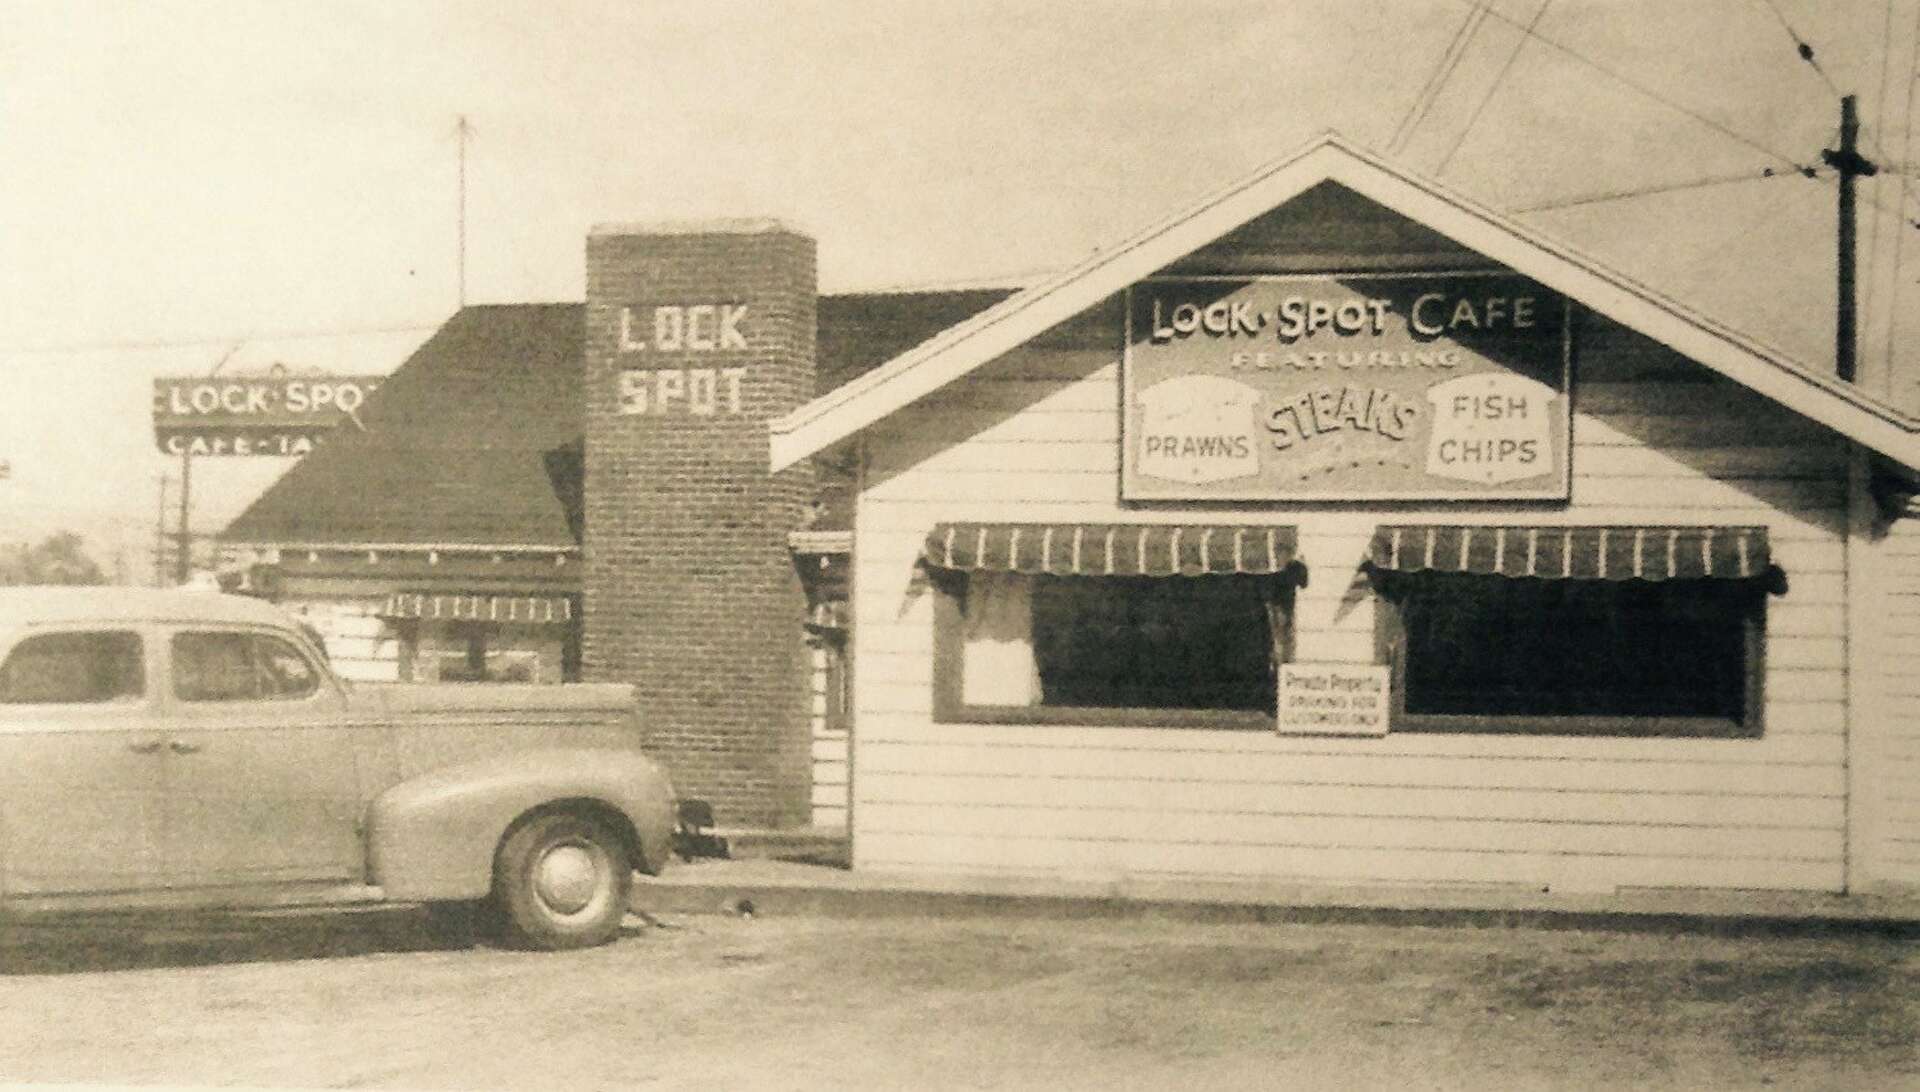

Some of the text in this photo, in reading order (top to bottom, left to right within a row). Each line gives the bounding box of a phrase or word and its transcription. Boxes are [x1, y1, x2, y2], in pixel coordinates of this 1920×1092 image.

[619, 304, 748, 351] LOCK
[1152, 292, 1536, 344] LOCK SPOT CAFE
[1230, 352, 1460, 370] FEATURING
[618, 366, 748, 415] SPOT
[1452, 395, 1528, 420] FISH
[1265, 386, 1416, 450] STEAKS
[1145, 434, 1250, 459] PRAWNS
[1439, 438, 1538, 465] CHIPS
